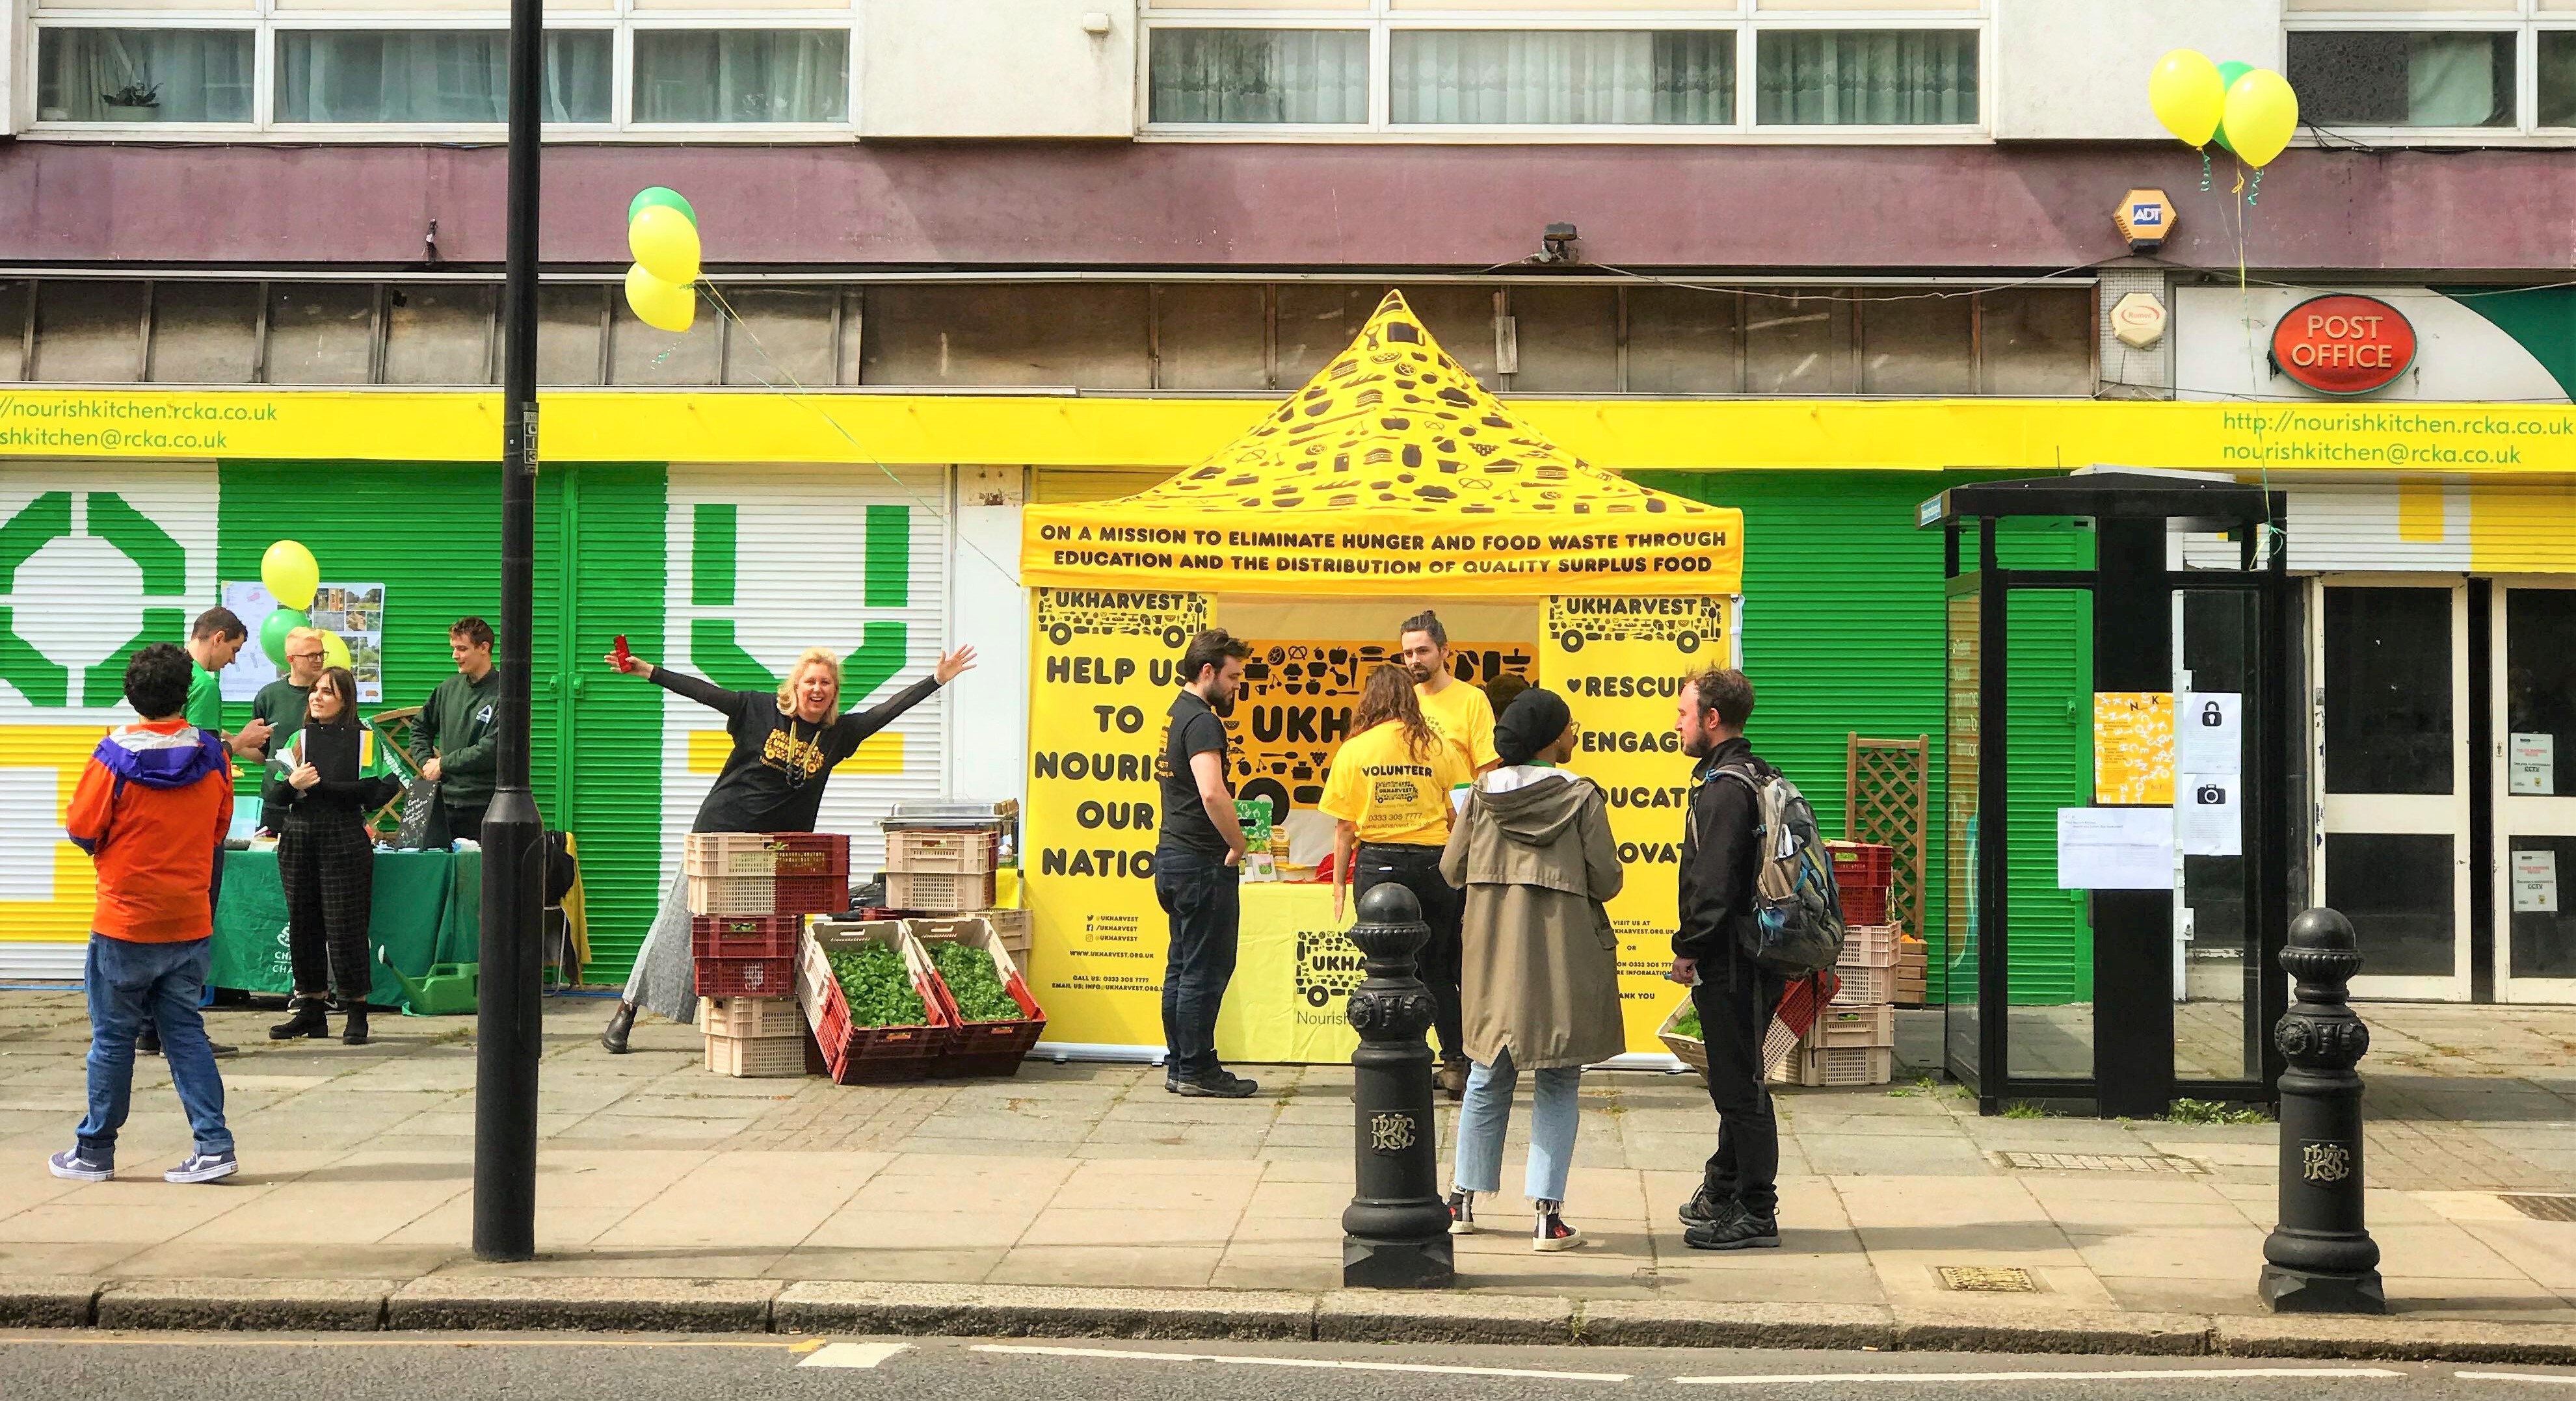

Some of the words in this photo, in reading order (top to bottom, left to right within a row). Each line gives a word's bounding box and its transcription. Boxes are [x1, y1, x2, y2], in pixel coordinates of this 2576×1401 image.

[2133, 208, 2161, 221] ADT
[2307, 313, 2384, 339] POST
[2291, 342, 2394, 369] OFFICE
[2222, 410, 2574, 436] http://nourishkitchen.rcka.co.uk
[2222, 441, 2521, 465] nourishkitchen@rcka.co.uk
[1041, 525, 1070, 540] ON
[1078, 527, 1091, 540] A
[1100, 527, 1186, 543] MISSION
[1193, 530, 1221, 545] TO
[1229, 531, 1334, 547] ELIMINATE
[1342, 534, 1424, 550] HUNGER
[1431, 536, 1475, 550] AND
[1483, 536, 1541, 551] FOOD
[1548, 535, 1618, 550] WASTE
[1625, 532, 1725, 547] THROUGH
[1054, 551, 1172, 568] EDUCATION
[1180, 555, 1223, 569] AND
[1230, 556, 1269, 570] THE
[1277, 557, 1421, 574] DISTRIBUTION
[1429, 561, 1455, 573] OF
[1463, 560, 1550, 575] QUALITY
[1558, 557, 1646, 572] SURPLUS
[1654, 557, 1711, 571] FOOD
[1056, 592, 1184, 610] UKHARVEST
[1567, 597, 1697, 615] UKHARVEST
[1046, 656, 1135, 685] HELP
[1093, 705, 1143, 733] TO
[1253, 705, 1353, 744] UKH
[1582, 731, 1684, 753] ENGAG
[1034, 752, 1161, 783] NOURI
[1362, 765, 1432, 777] VOLUNTEER
[1076, 801, 1154, 830] OUR
[1041, 847, 1155, 879] NATIO
[1313, 956, 1367, 971] UKHA
